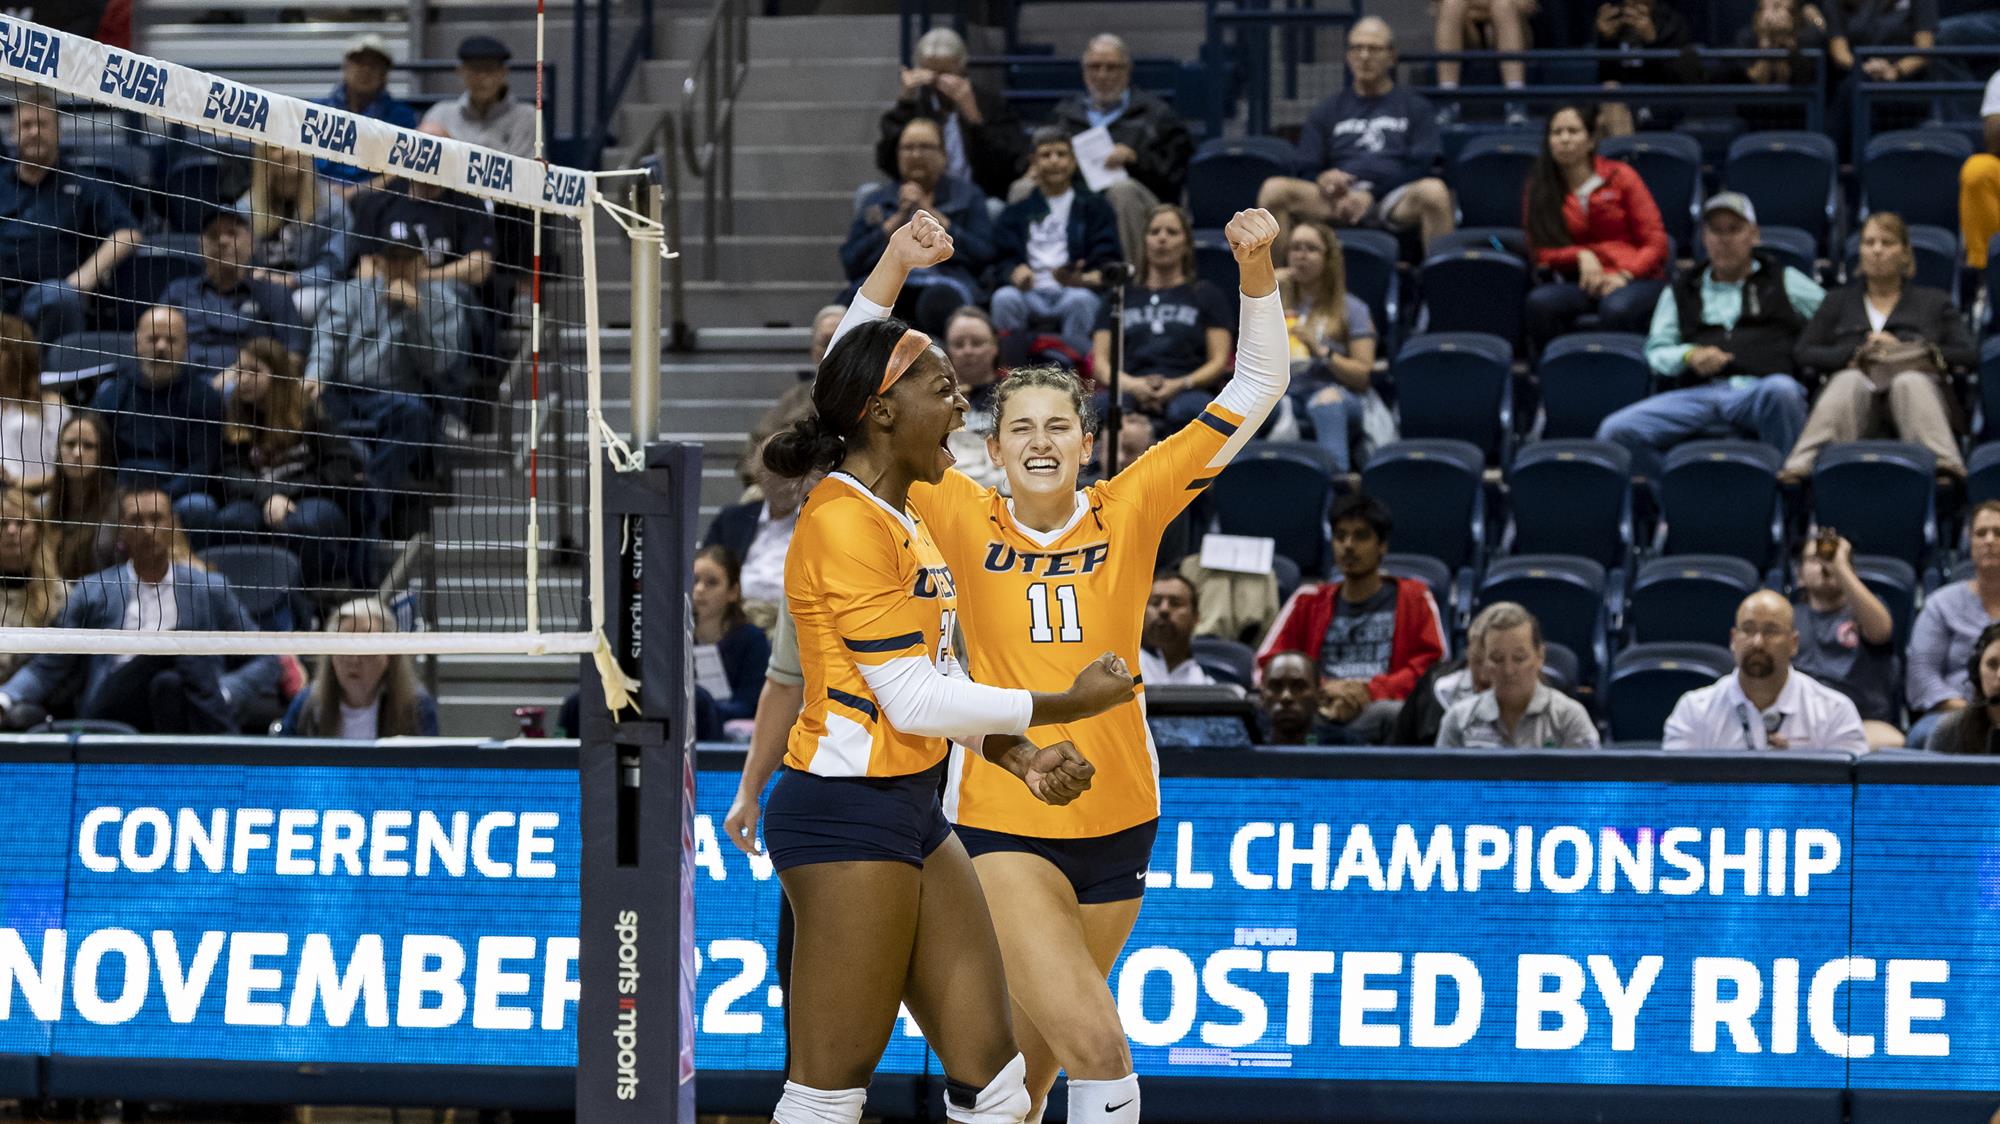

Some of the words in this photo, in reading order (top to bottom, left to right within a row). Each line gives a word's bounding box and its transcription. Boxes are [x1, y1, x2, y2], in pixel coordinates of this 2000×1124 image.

[984, 542, 1110, 577] UTEP
[1026, 582, 1083, 643] 11
[79, 807, 559, 878] CONFERENCE
[1230, 821, 1842, 896] CHAMPIONSHIP
[614, 910, 640, 994] sports
[1117, 946, 1485, 1048] OSTED
[1515, 953, 1664, 1050] BY
[1690, 956, 1950, 1058] RICE
